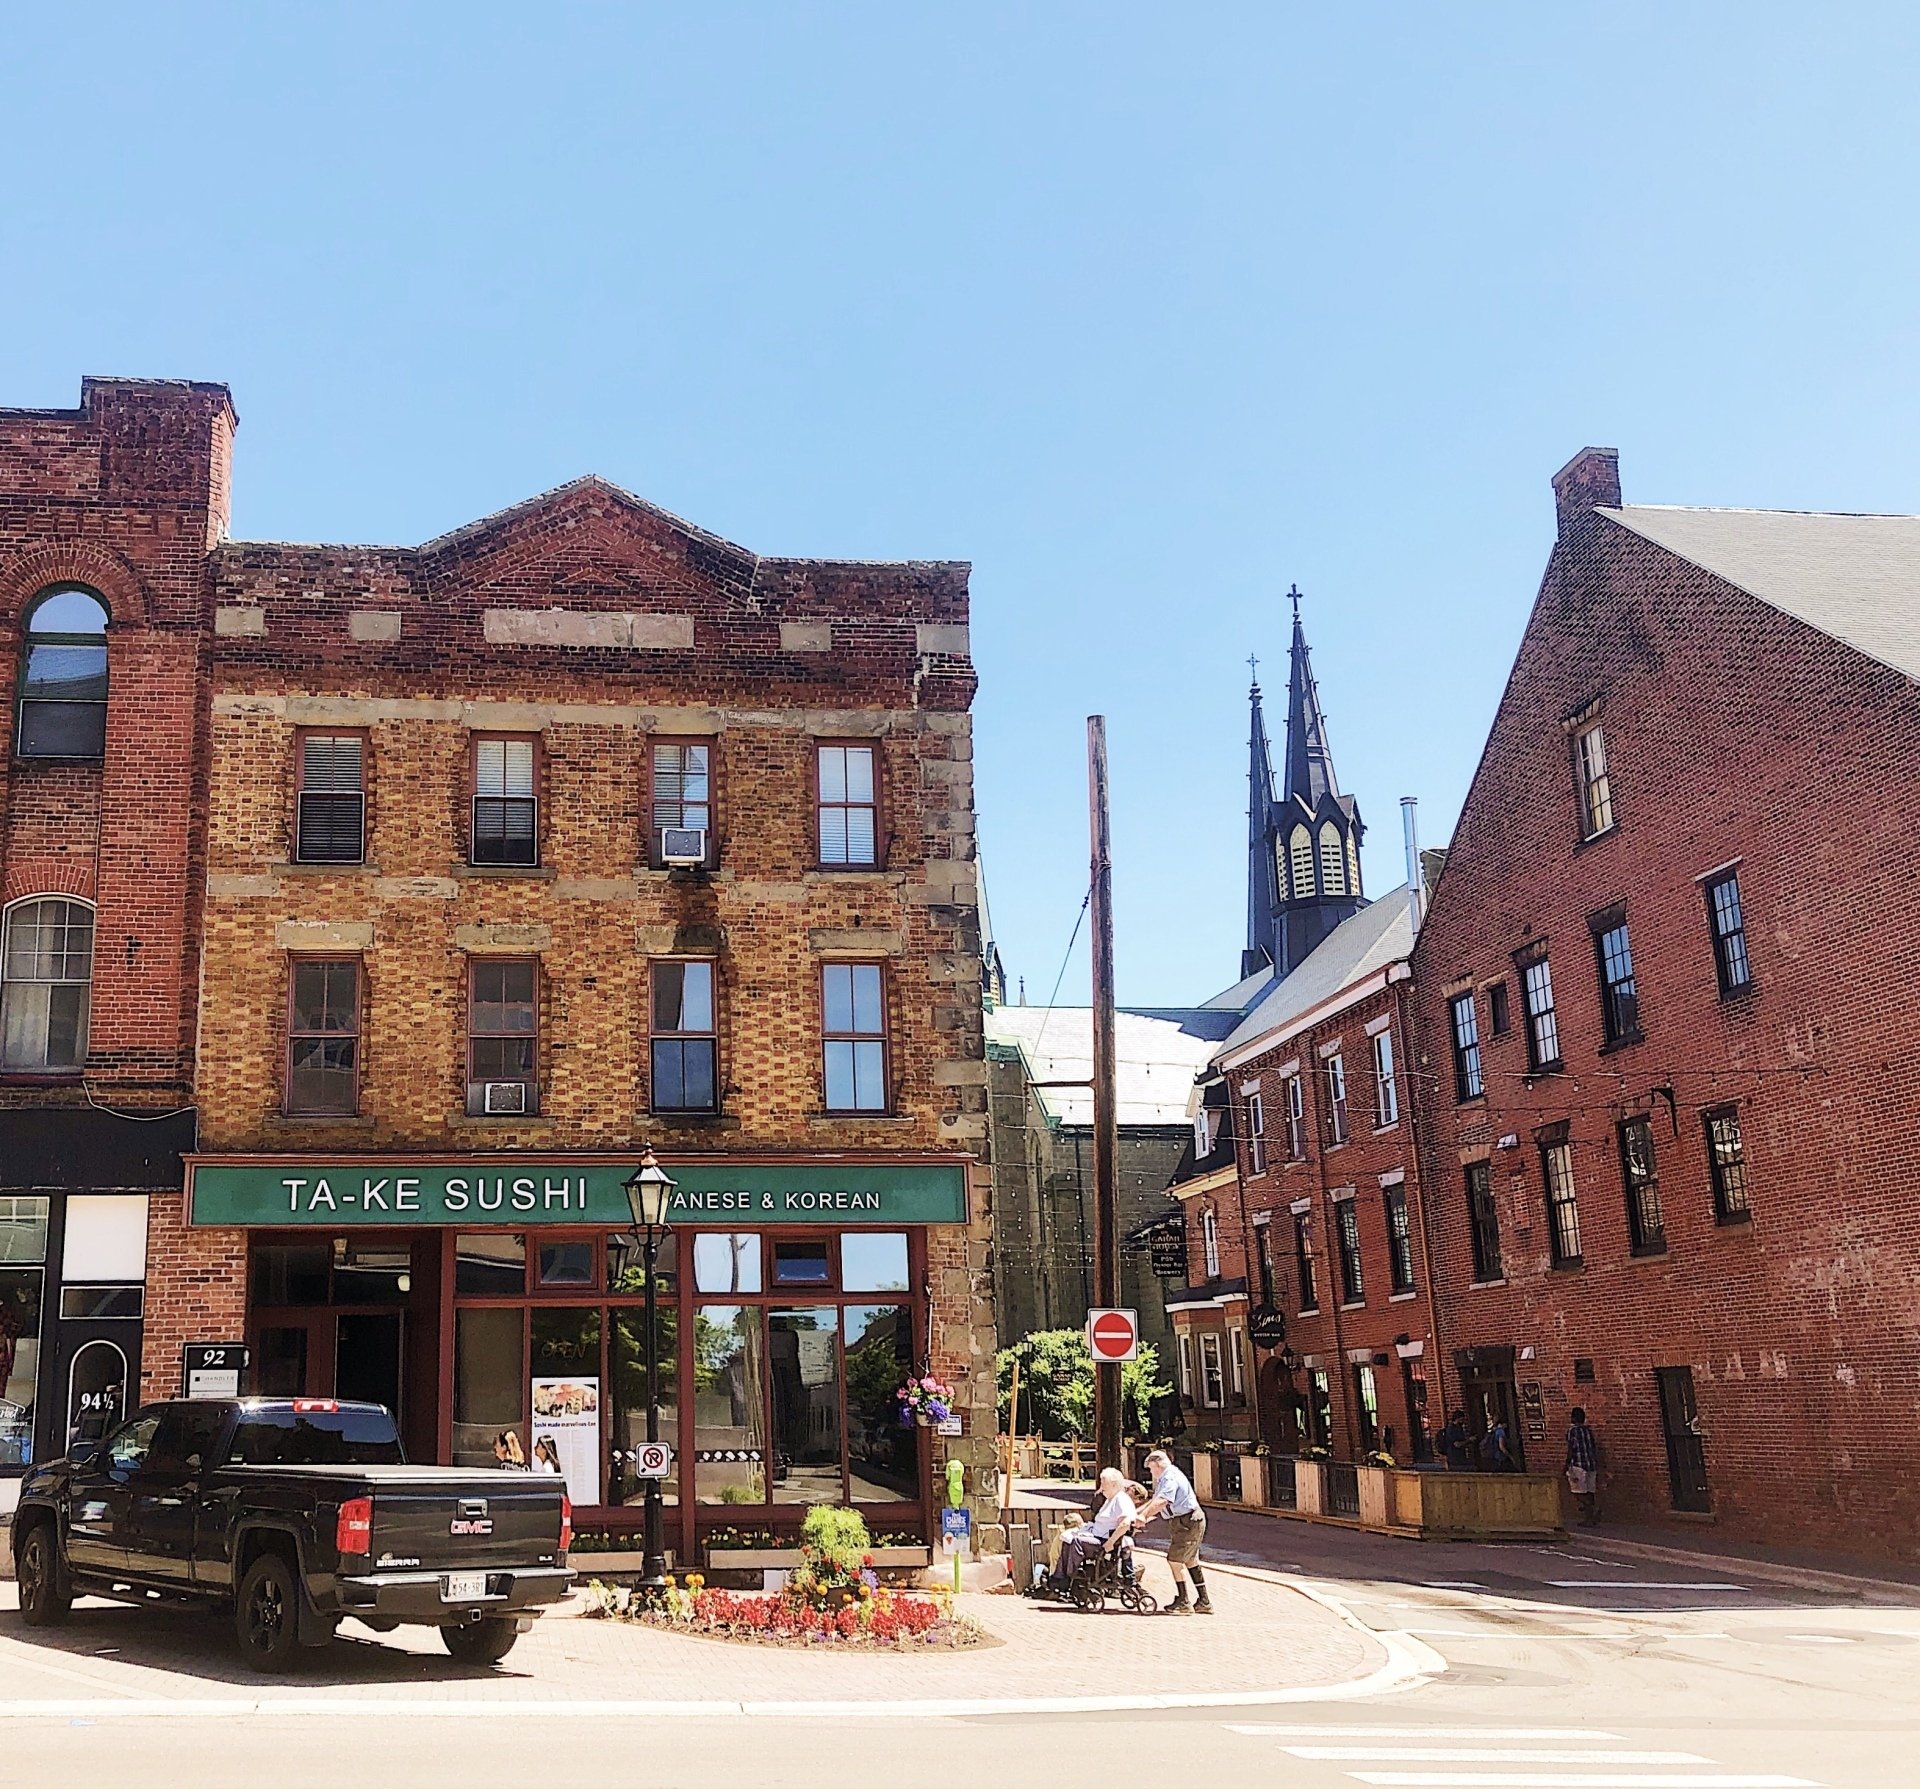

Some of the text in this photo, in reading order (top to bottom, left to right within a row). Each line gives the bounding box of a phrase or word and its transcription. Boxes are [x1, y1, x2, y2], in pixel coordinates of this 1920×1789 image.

[282, 1177, 586, 1211] TA-KE SUSHI
[670, 1192, 880, 1209] ANESE & KOREAN
[202, 1349, 226, 1367] 92
[450, 1519, 493, 1534] GMC
[376, 1558, 420, 1567] SIERRA
